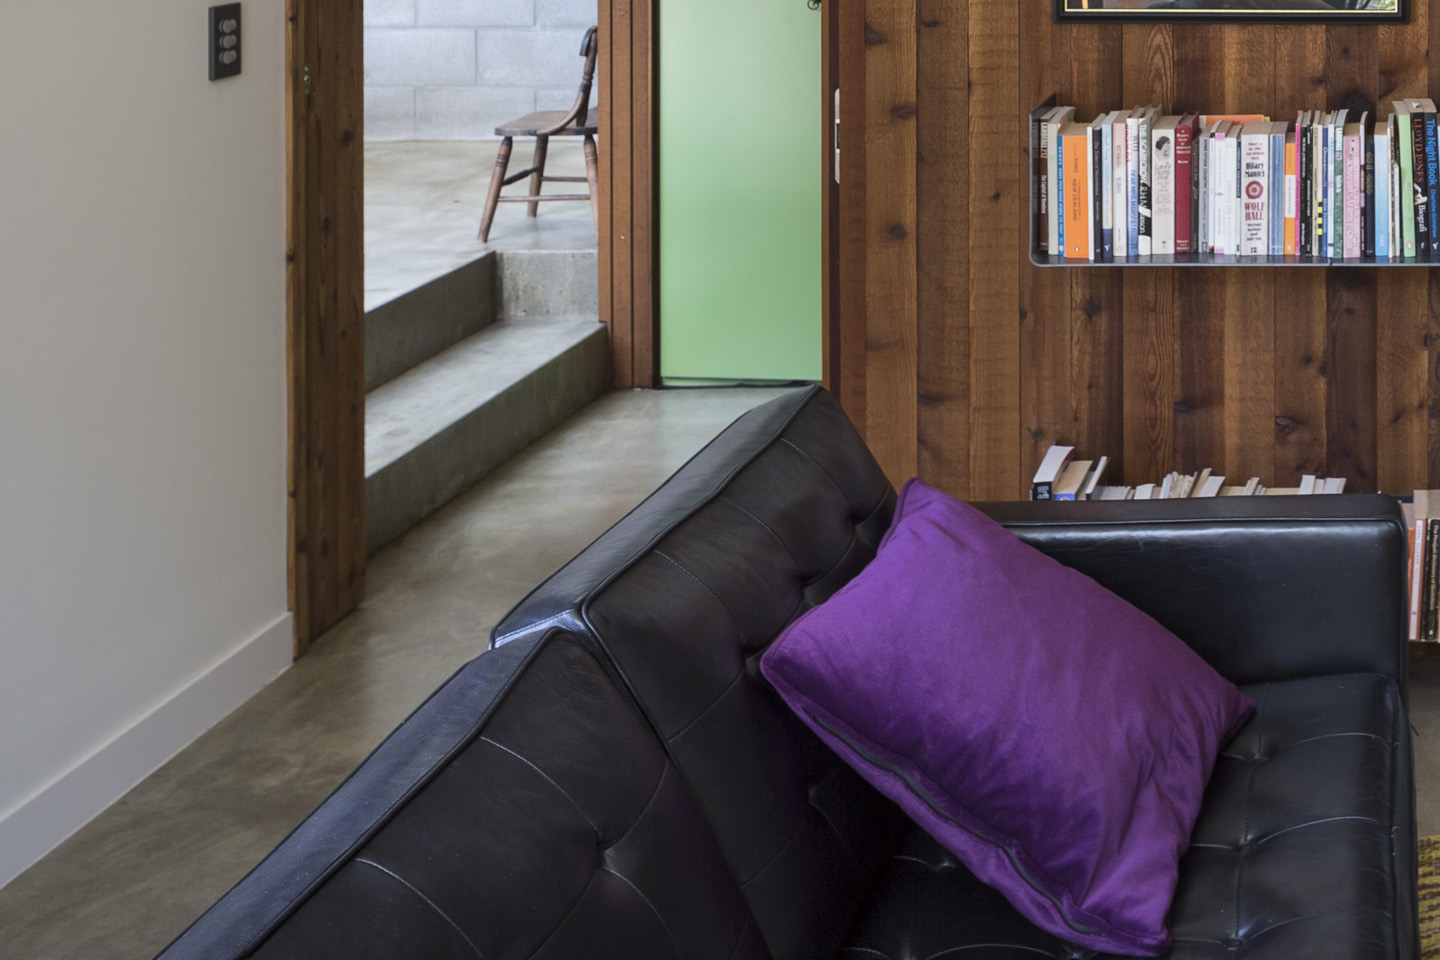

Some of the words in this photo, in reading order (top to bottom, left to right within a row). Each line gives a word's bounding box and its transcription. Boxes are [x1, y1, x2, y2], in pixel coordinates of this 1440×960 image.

[1414, 118, 1423, 151] LLOYD
[1426, 120, 1435, 135] The
[1426, 137, 1437, 161] Night
[1415, 154, 1424, 182] JONES
[1428, 163, 1438, 185] Book
[1245, 202, 1264, 211] WOLF
[1245, 212, 1264, 220] HALL
[1417, 204, 1427, 232] Biografi
